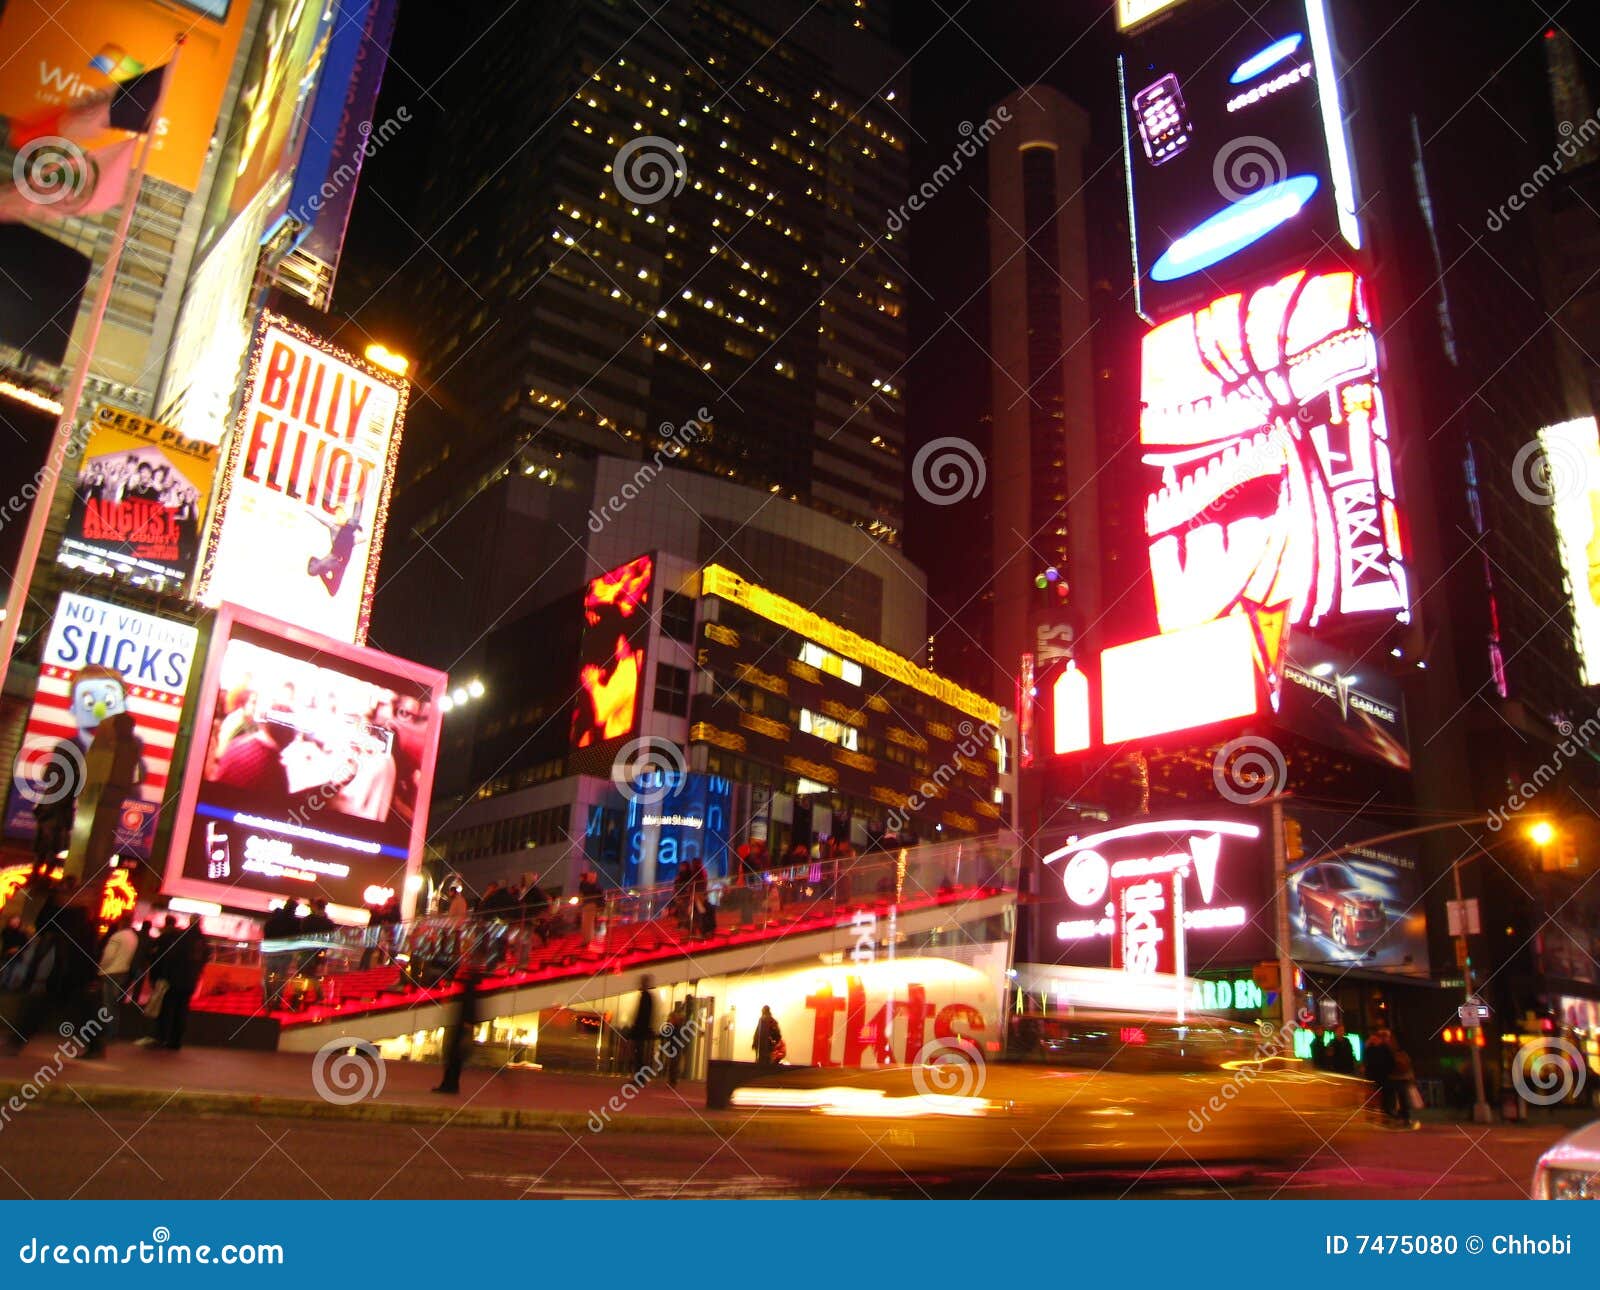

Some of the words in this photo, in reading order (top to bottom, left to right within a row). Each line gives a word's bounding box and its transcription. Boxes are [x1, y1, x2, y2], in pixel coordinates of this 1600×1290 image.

[260, 340, 373, 444] BILLY
[161, 430, 214, 454] PLAY
[243, 411, 376, 516] ELLIOT
[83, 496, 181, 536] AUGUST
[66, 601, 107, 626] NOT
[118, 615, 190, 649] VOTING
[57, 624, 186, 687] SUCKS
[1284, 668, 1338, 699] PONTIAC
[805, 976, 985, 1067] tkts
